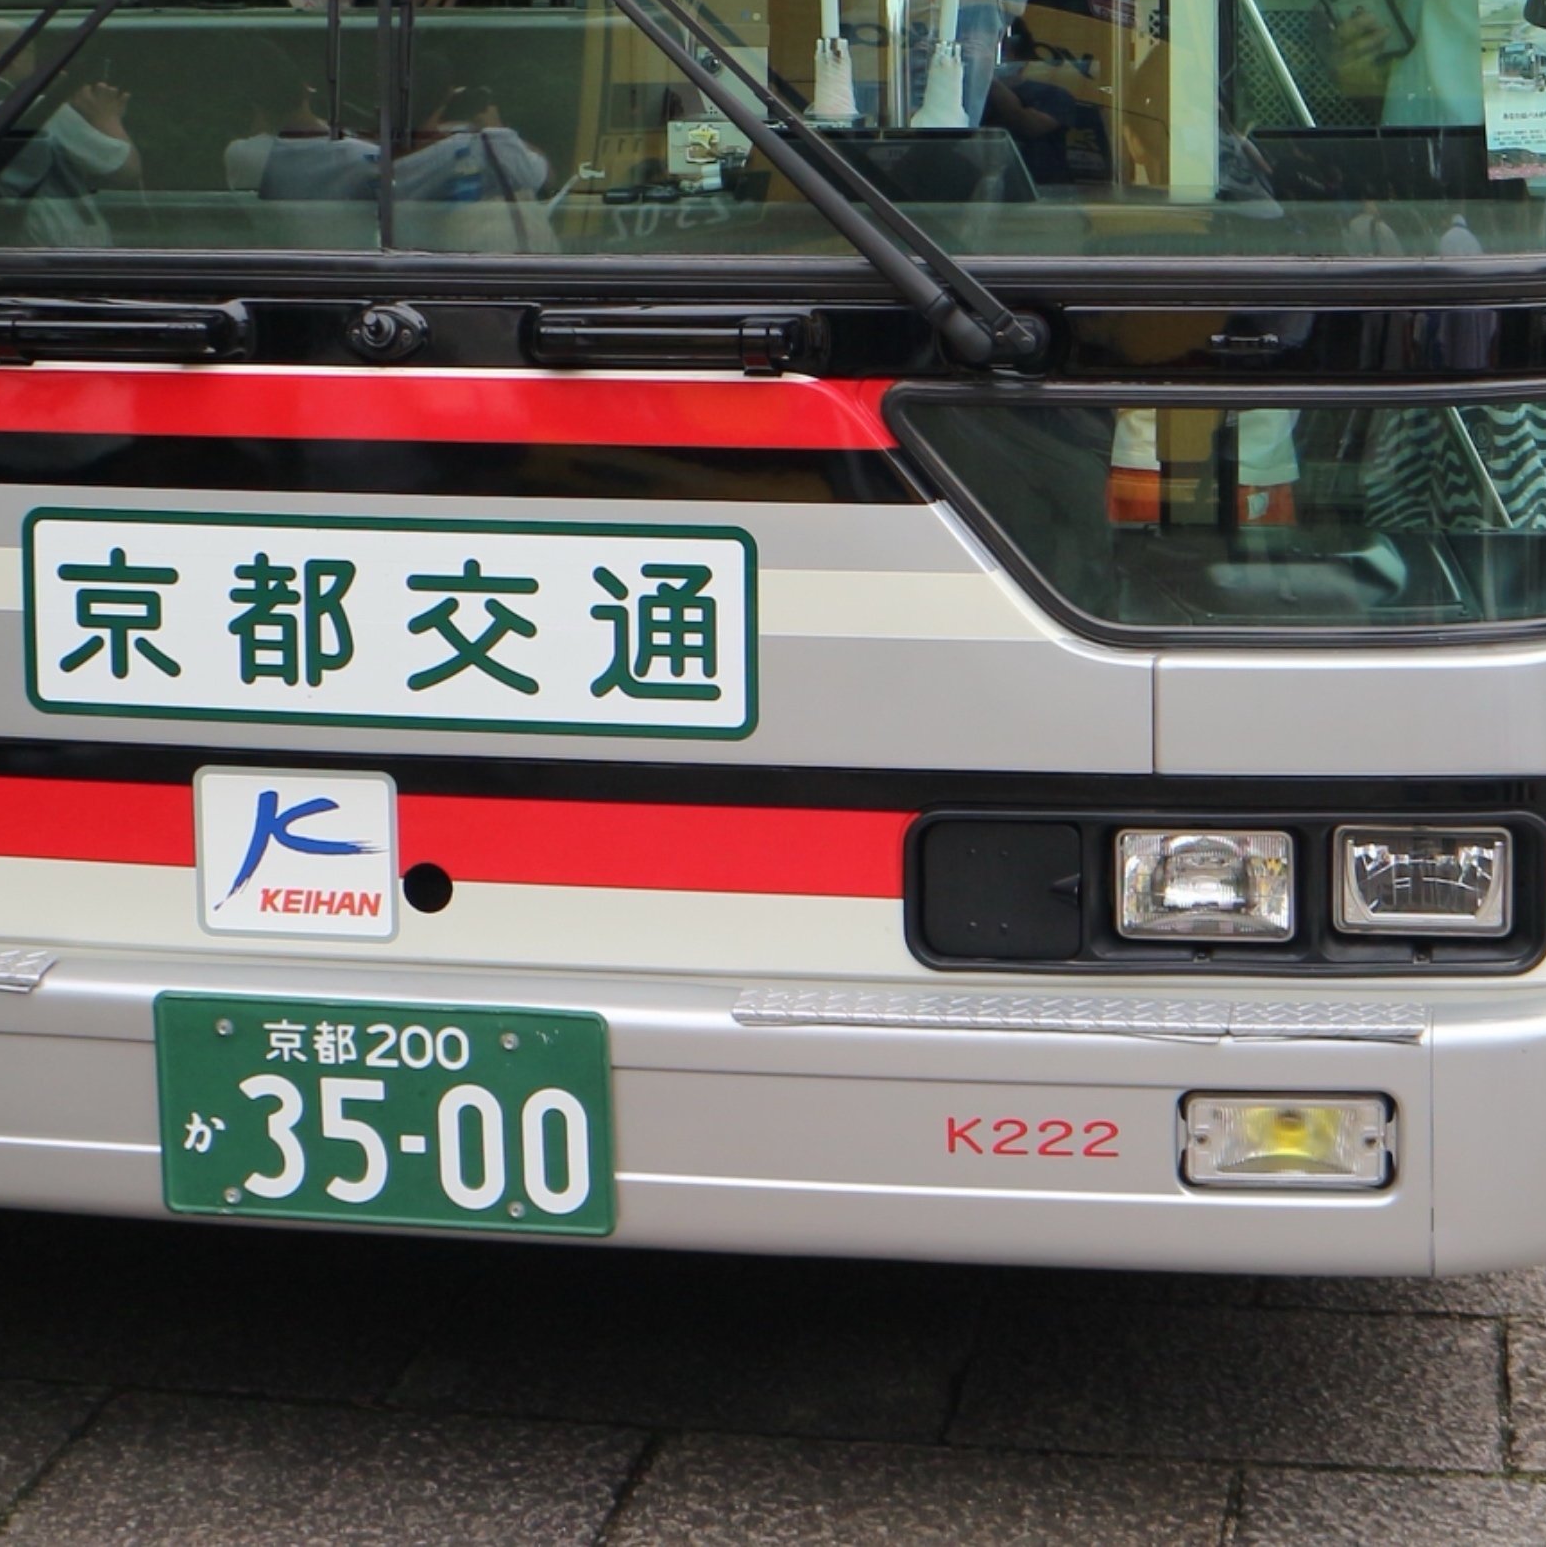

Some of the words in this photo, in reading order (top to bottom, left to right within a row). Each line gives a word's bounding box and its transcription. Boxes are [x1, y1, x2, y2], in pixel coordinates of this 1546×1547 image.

[57, 547, 722, 700] 京都交通
[259, 888, 382, 918] KEIHAN
[183, 1111, 226, 1153] か
[239, 1073, 590, 1215] 35-00
[947, 1116, 1120, 1158] K222
